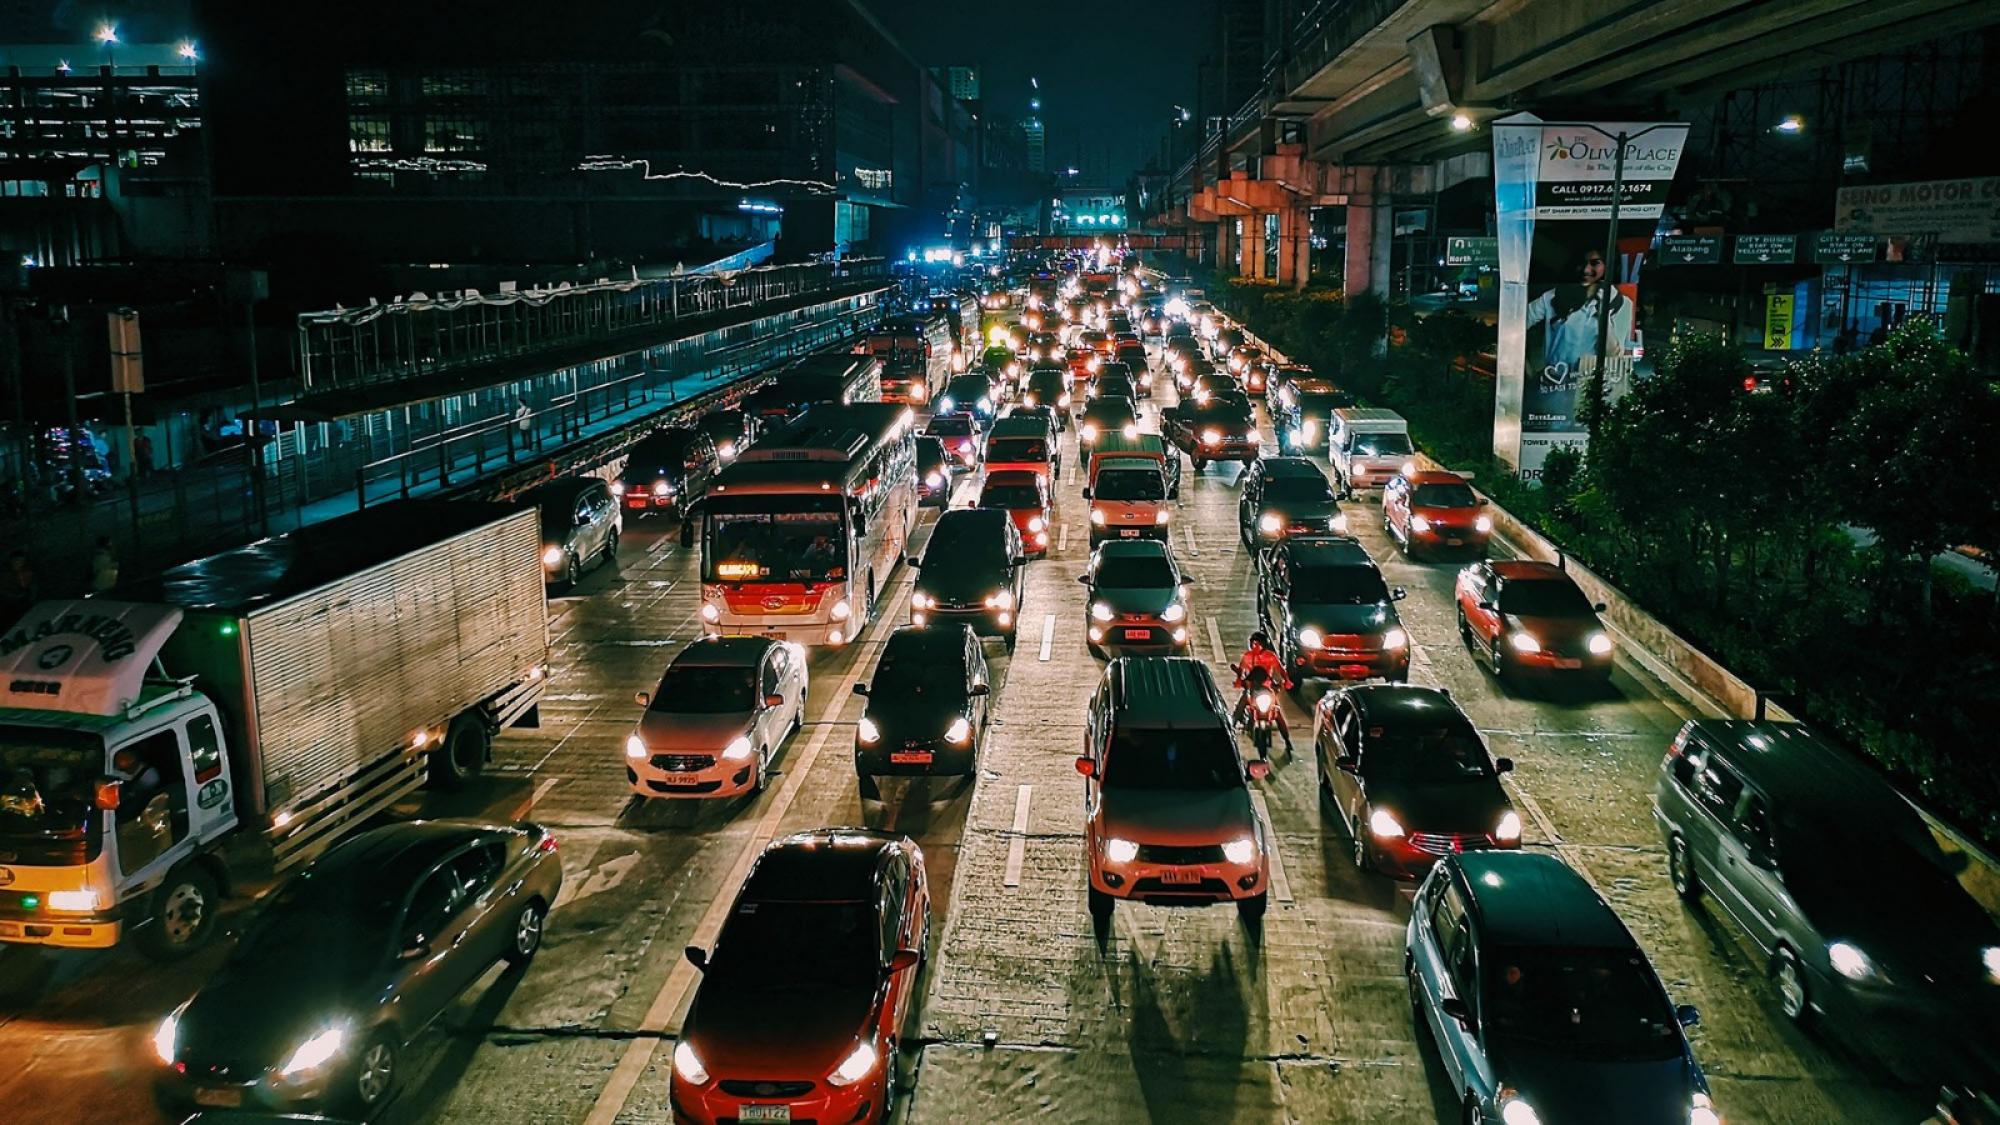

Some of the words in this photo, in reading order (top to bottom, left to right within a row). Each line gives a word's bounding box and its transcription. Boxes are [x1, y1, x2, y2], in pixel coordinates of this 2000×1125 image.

[1569, 142, 1618, 160] OLIV
[1624, 144, 1678, 160] PLACE
[1551, 185, 1577, 194] CALL
[1579, 184, 1652, 193] 0917.69.1674
[1898, 182, 1974, 202] MOTOR
[1738, 235, 1760, 243] CITY
[1763, 235, 1794, 243] BUSES
[1819, 235, 1840, 243] CITY
[1670, 245, 1710, 255] Alabang
